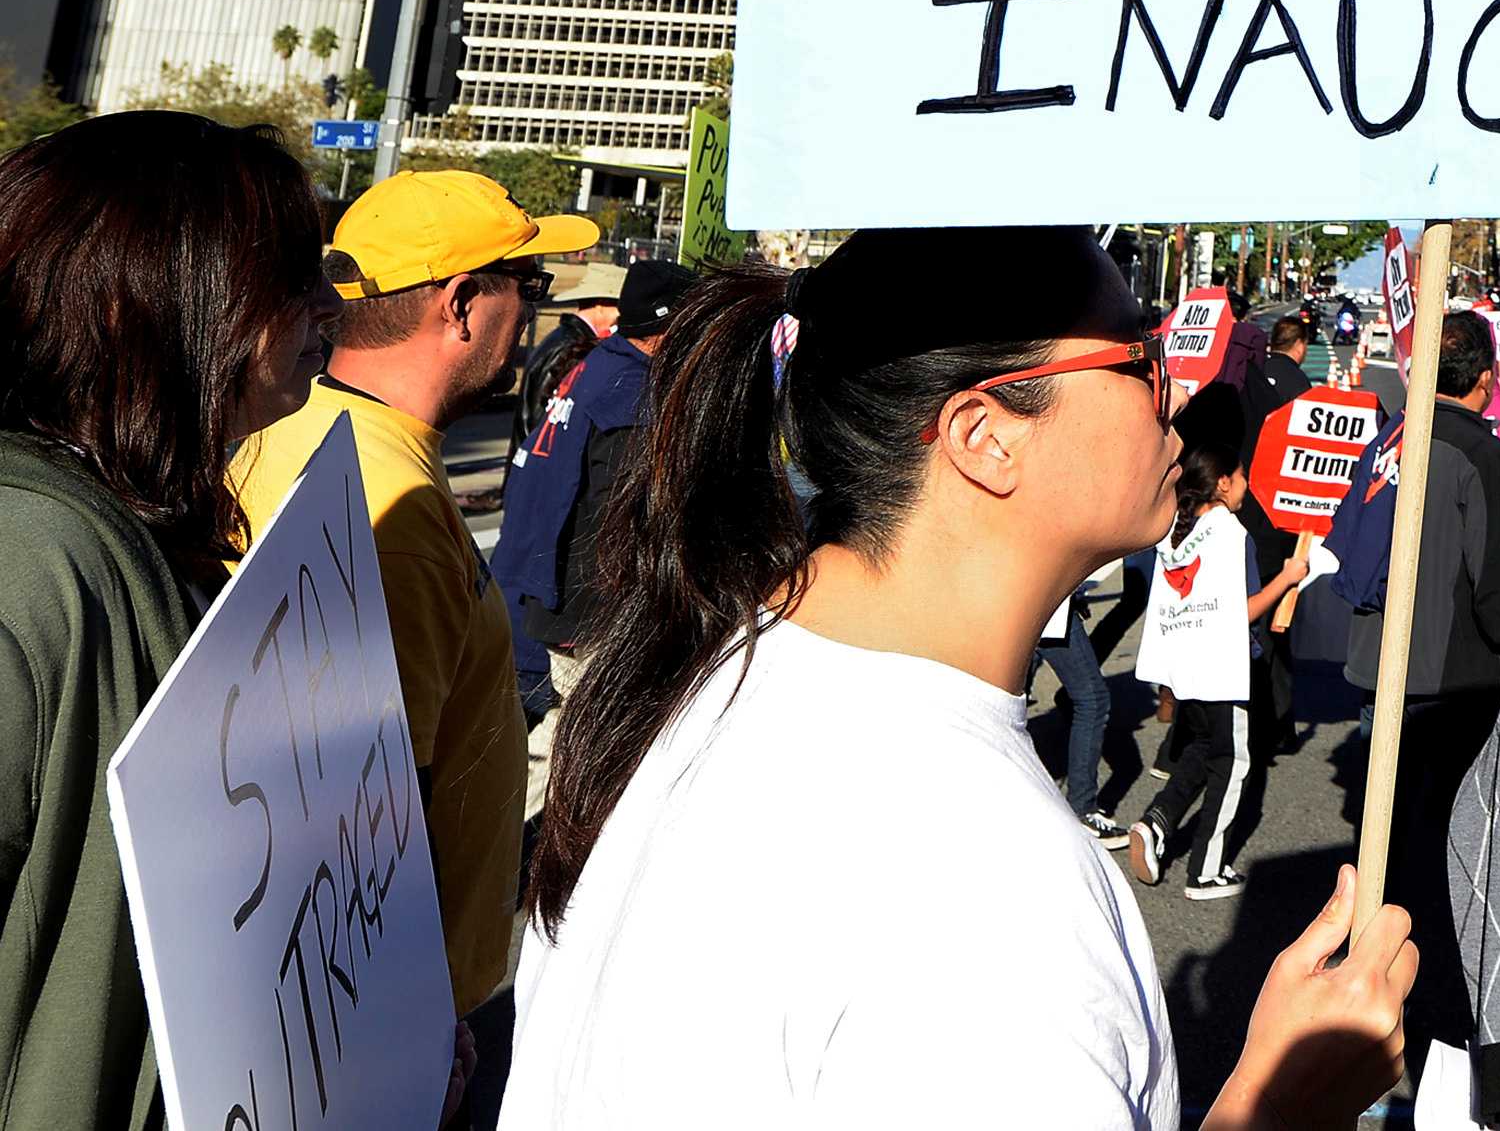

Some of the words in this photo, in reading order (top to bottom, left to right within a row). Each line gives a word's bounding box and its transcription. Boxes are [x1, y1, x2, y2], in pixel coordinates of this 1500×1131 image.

[1169, 331, 1208, 353] Trump
[1307, 407, 1365, 440] Stop
[219, 474, 372, 931] STAY
